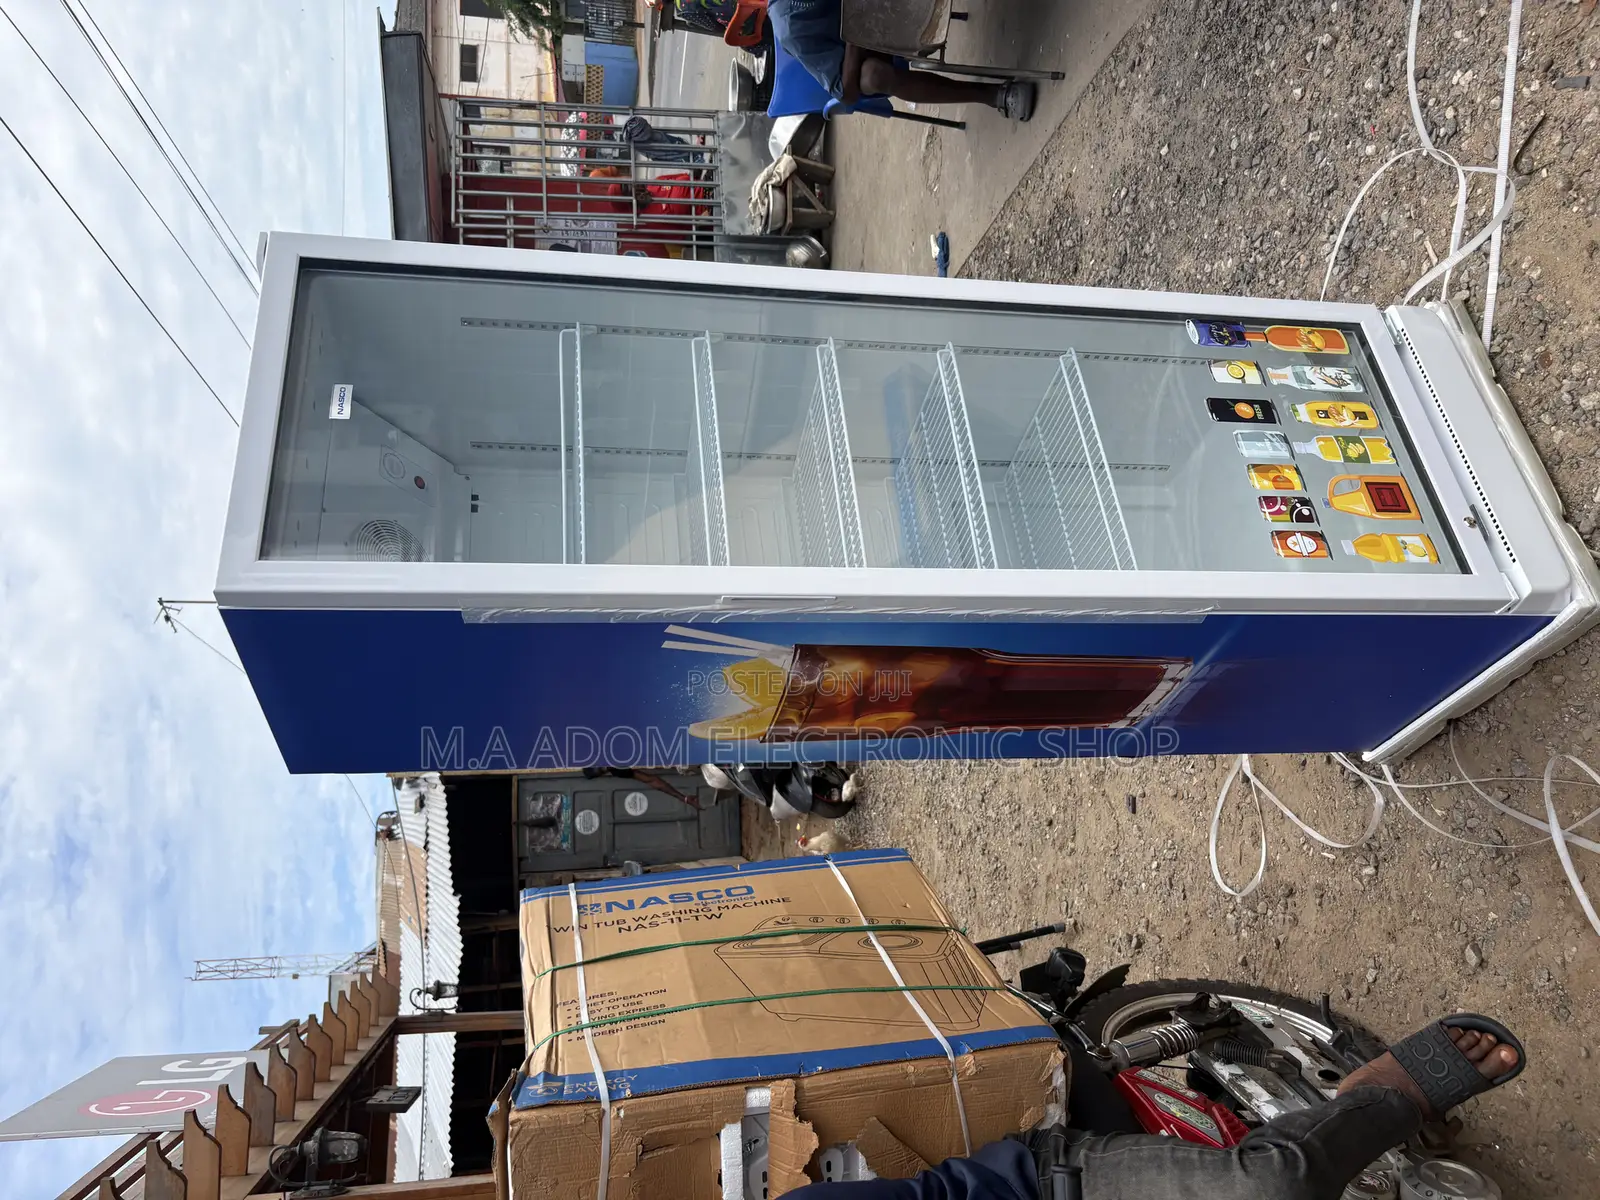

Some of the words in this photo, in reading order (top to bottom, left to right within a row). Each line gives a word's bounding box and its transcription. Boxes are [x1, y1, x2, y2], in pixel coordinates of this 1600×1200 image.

[337, 386, 347, 415] NASCO
[1253, 404, 1265, 420] FRESH
[605, 885, 755, 913] NASCO
[594, 918, 627, 928] TUB
[631, 906, 712, 923] WASHING
[717, 896, 792, 911] MACHINE
[618, 912, 723, 934] NAS-11-TW
[556, 991, 618, 1008] FEAURES:
[608, 988, 667, 1003] OPERATION
[575, 1007, 603, 1018] ESY
[622, 1000, 643, 1008] USE
[576, 1012, 616, 1026] DYING
[618, 1003, 666, 1016] EXPRESS
[577, 1027, 623, 1041] MDERN
[626, 1018, 666, 1031] DESIGN
[135, 1056, 248, 1086] LG
[564, 1082, 631, 1095] SAVNG
